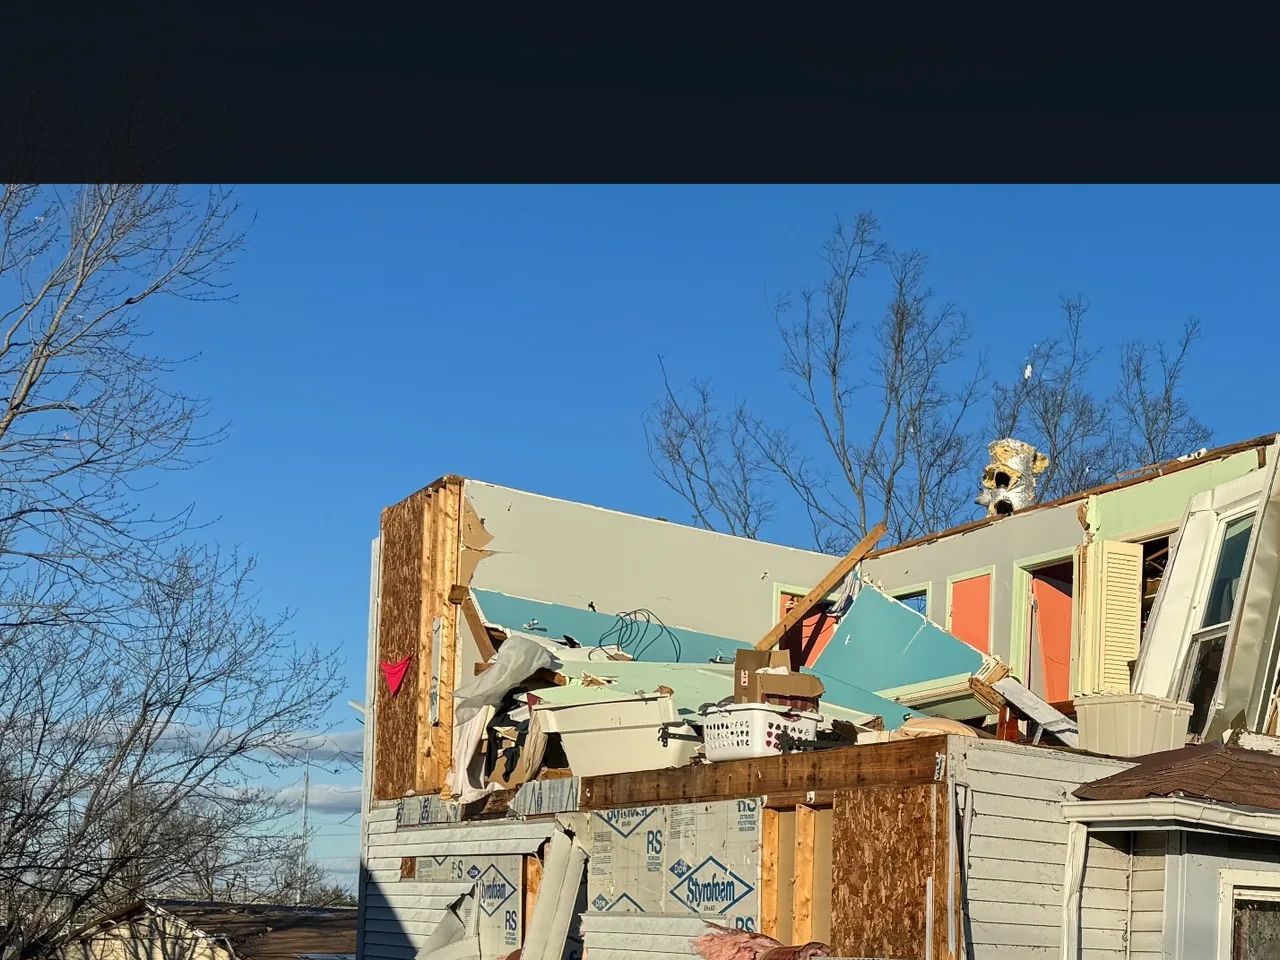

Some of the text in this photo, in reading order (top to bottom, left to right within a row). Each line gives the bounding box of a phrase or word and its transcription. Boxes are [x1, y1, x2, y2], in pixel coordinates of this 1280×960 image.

[647, 830, 663, 854] RS
[686, 875, 735, 907] Styrofoam
[505, 910, 517, 931] RS
